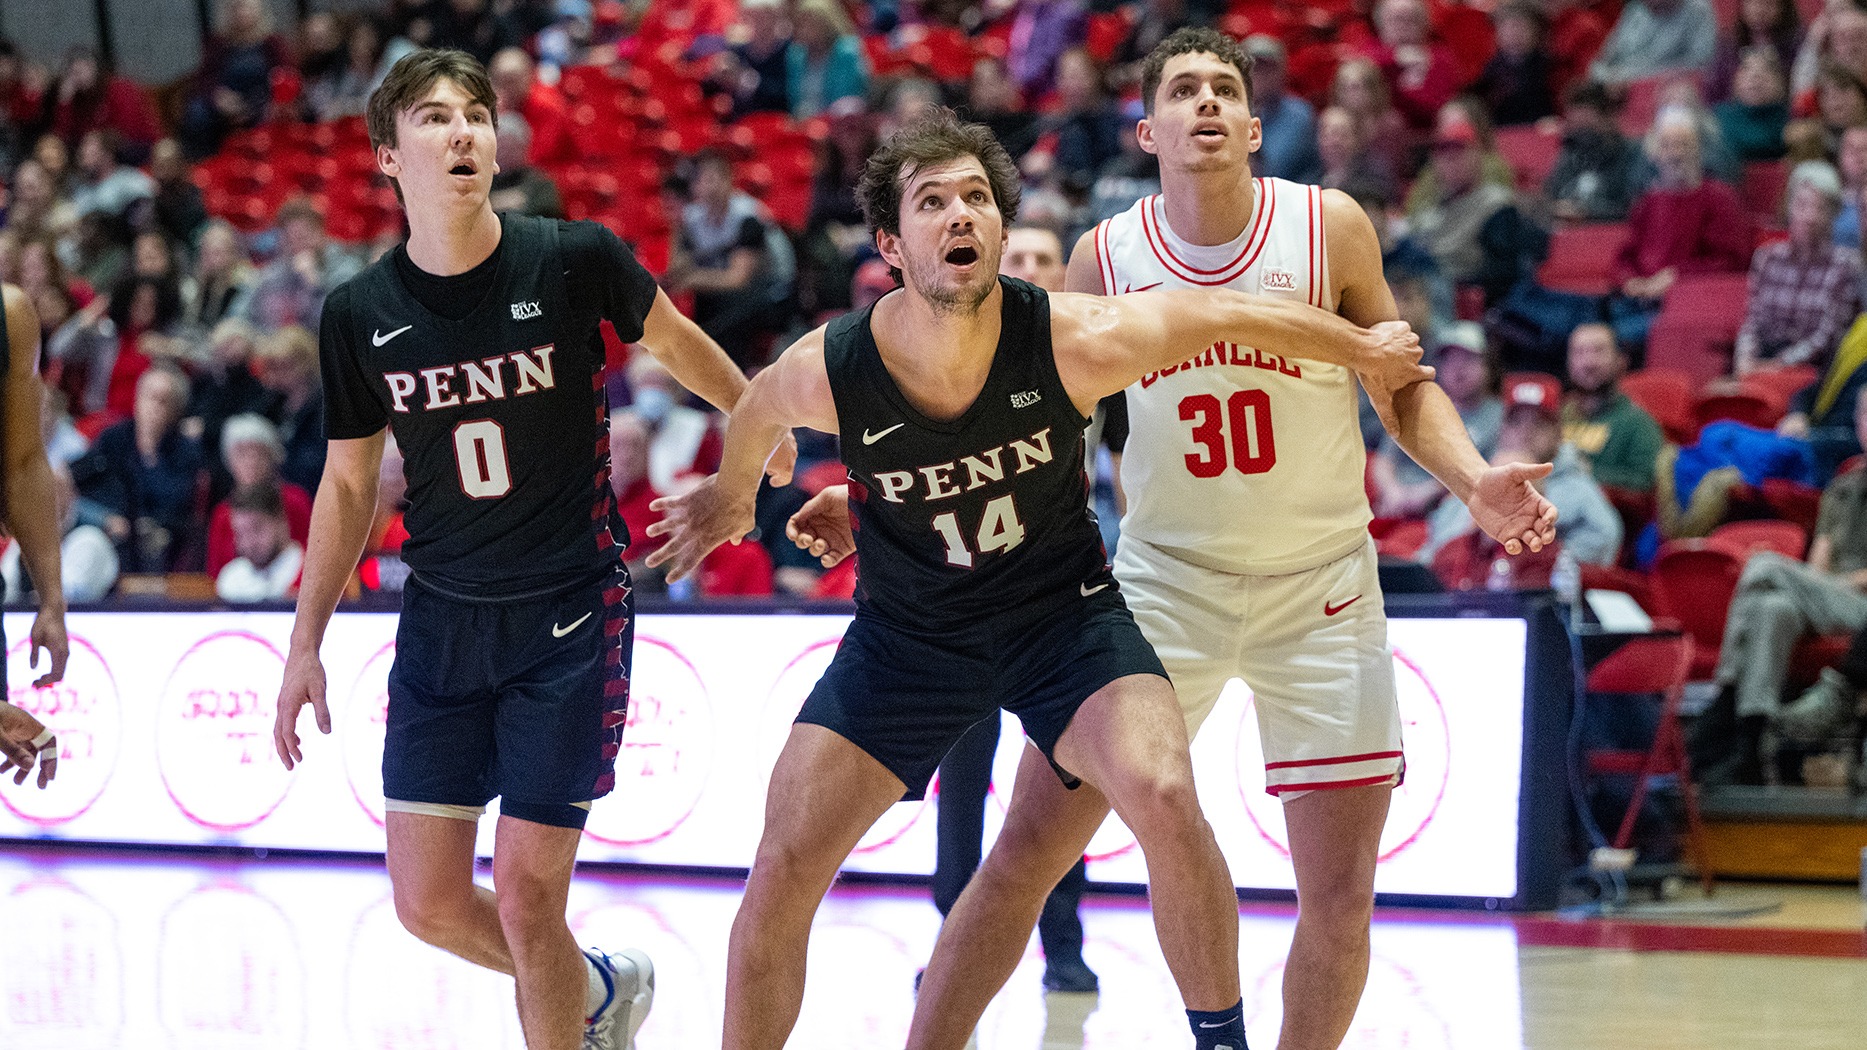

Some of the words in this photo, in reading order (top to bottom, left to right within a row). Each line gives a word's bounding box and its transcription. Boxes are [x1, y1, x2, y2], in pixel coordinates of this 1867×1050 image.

[519, 301, 540, 315] IVY
[1271, 272, 1293, 283] IVY
[383, 343, 555, 413] PENN
[1019, 389, 1039, 404] IVY
[451, 417, 513, 500] 0
[872, 427, 1053, 503] PENN
[1178, 388, 1277, 478] 30
[931, 493, 1025, 570] 14
